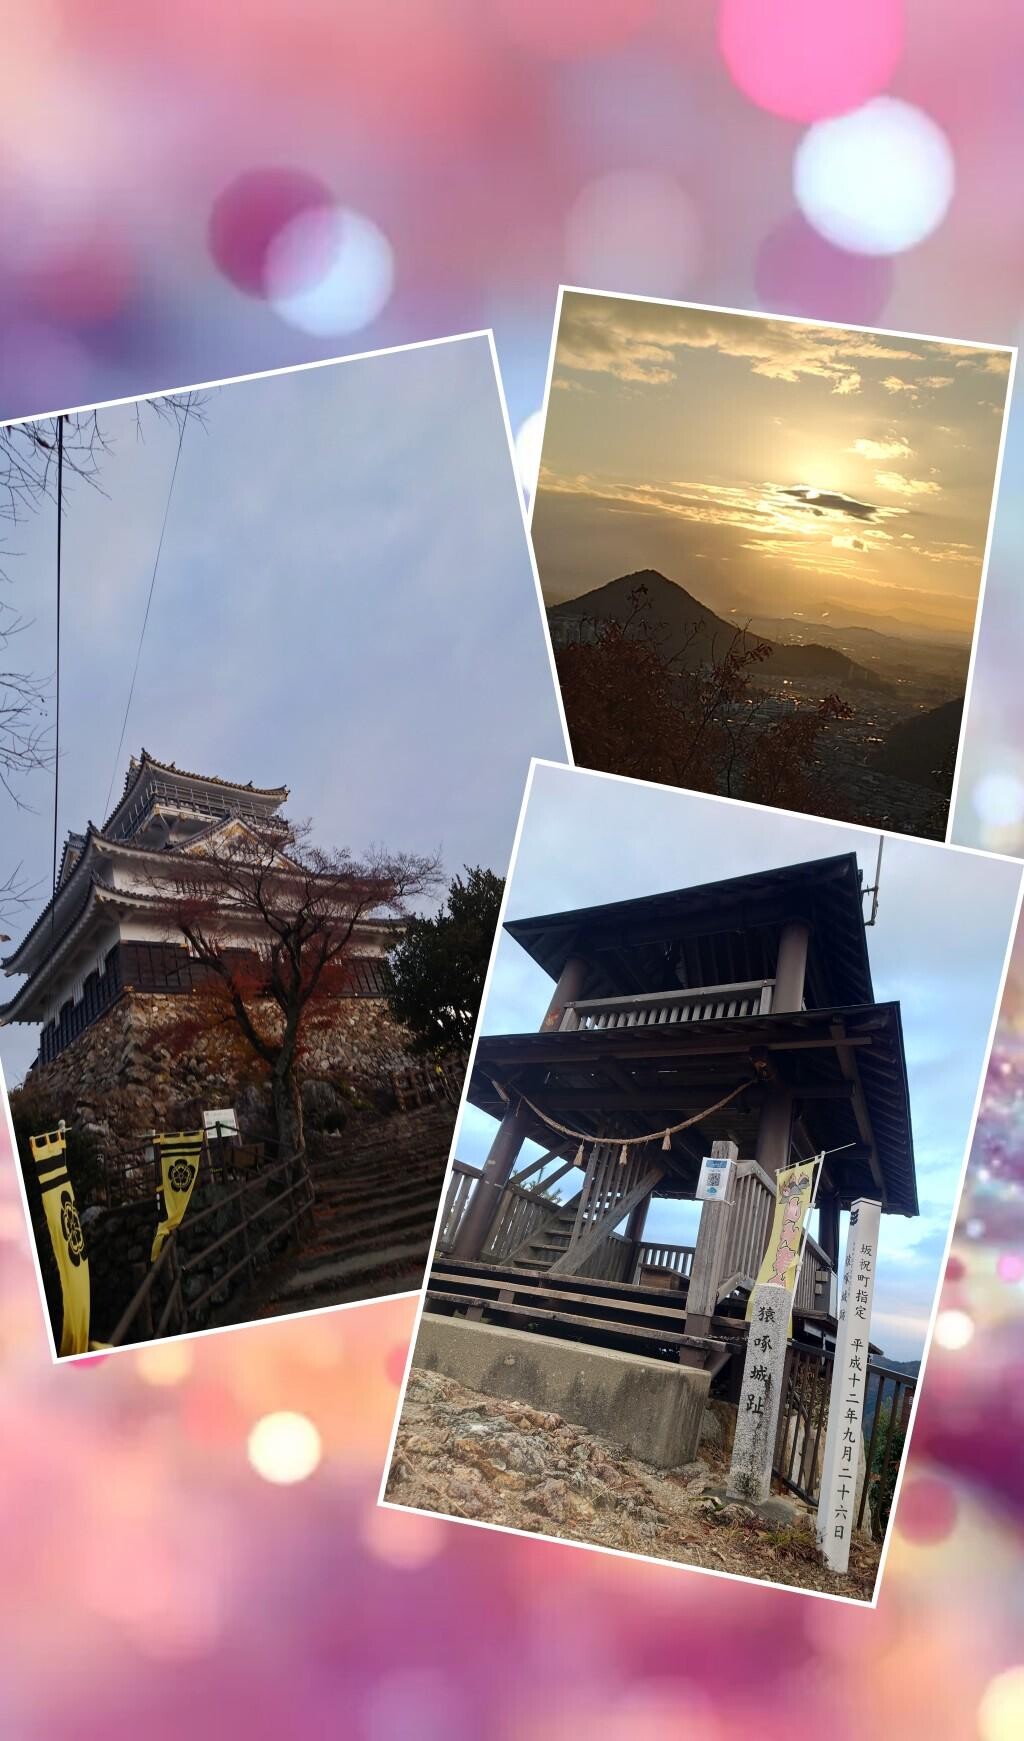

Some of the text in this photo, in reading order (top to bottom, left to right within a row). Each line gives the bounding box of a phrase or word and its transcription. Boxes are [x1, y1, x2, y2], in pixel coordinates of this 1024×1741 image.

[834, 1243, 872, 1540] 坂祝町指定 平成十二年九月二十六日
